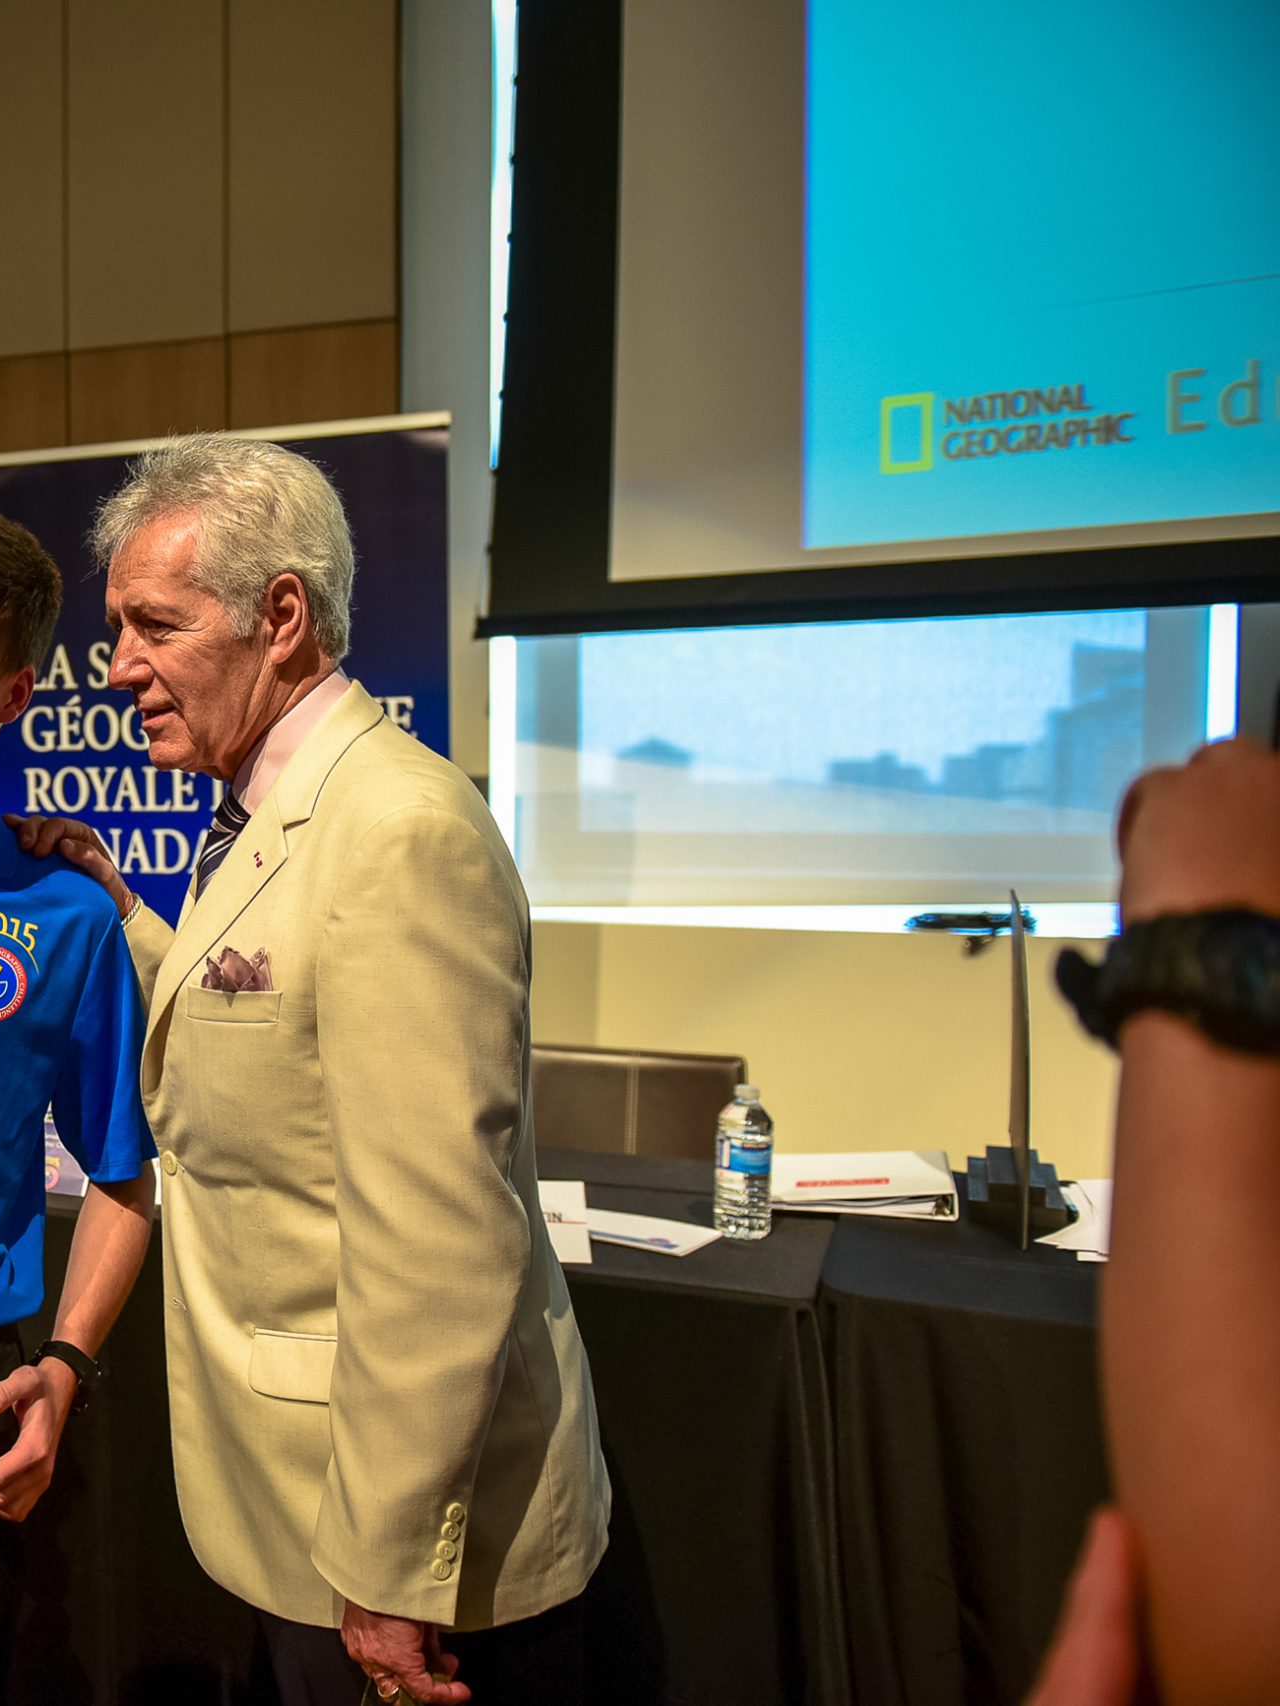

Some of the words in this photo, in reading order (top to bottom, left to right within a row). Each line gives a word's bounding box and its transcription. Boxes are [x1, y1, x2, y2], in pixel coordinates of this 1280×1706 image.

[942, 383, 1092, 426] NATIONAL
[1166, 357, 1280, 435] Ed
[940, 412, 1136, 461] GEOGRAPHIC
[23, 765, 200, 813] ROYALE
